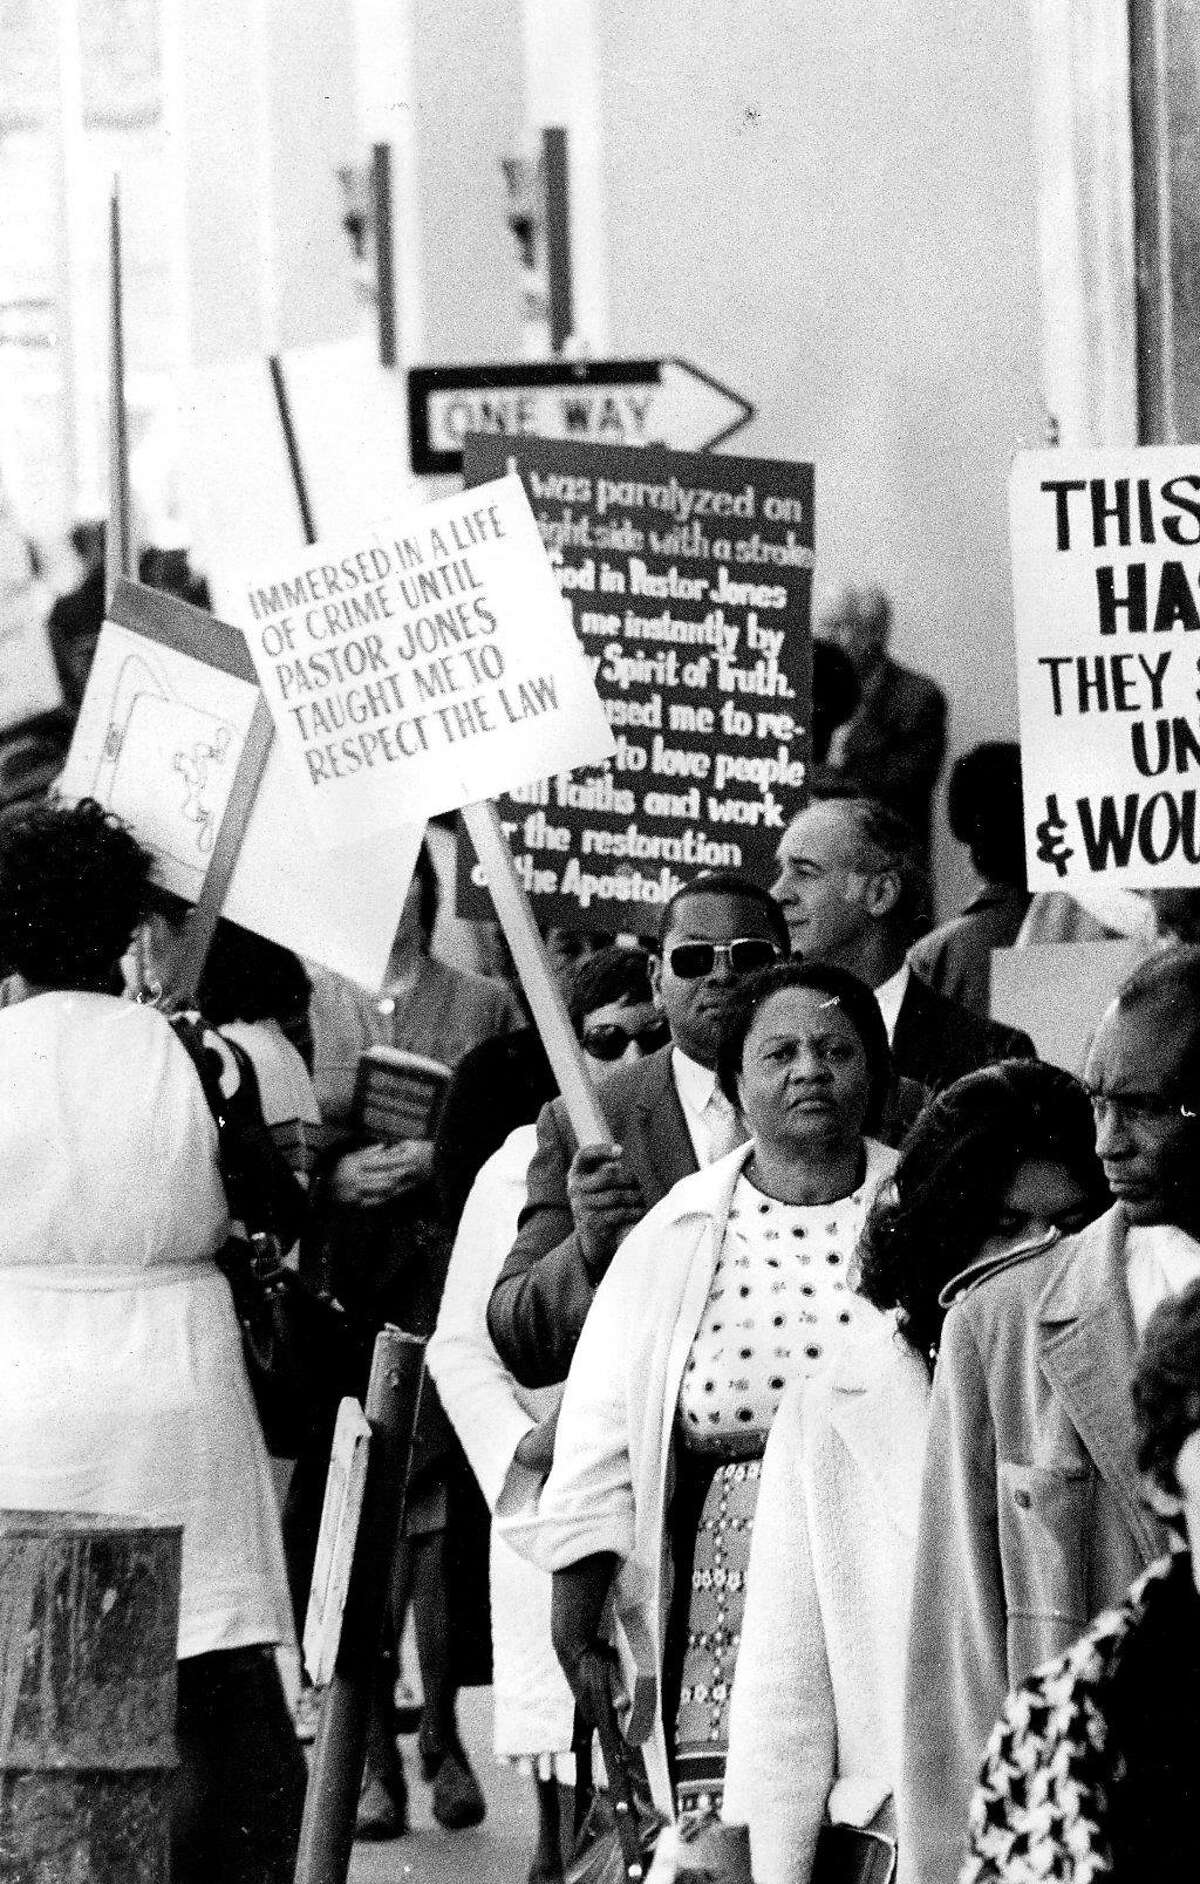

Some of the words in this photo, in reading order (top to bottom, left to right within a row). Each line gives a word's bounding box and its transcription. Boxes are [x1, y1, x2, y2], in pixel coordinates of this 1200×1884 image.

[445, 397, 537, 442] ONE
[562, 395, 653, 433] WAY
[530, 471, 592, 502] was
[598, 476, 755, 522] paralyzed
[763, 497, 802, 521] on
[248, 548, 391, 620] IMMERSED
[395, 537, 424, 569] IN
[430, 528, 450, 559] A
[450, 504, 506, 551] LIFE
[600, 563, 626, 594] in
[628, 557, 709, 601] Pastor
[709, 566, 788, 609] Jones
[261, 617, 296, 657] OF
[306, 585, 395, 640] CRIME
[400, 558, 484, 610] UNTIL
[581, 612, 622, 636] me
[624, 609, 740, 655] instantly
[746, 612, 785, 658] by
[275, 634, 389, 699] PASTOR
[399, 597, 498, 661] JONES
[601, 642, 681, 690] Spirit
[682, 655, 712, 688] of
[711, 652, 796, 698] Truth.
[289, 673, 404, 741] TAUGHT
[413, 656, 461, 702] ME
[461, 644, 505, 685] TO
[1038, 650, 1172, 716] THEY
[304, 716, 430, 786] RESPECT
[434, 696, 496, 744] THE
[499, 674, 560, 723] LAW
[668, 703, 714, 734] me
[720, 700, 754, 737] to
[756, 713, 806, 742] re-
[616, 735, 648, 771] to
[652, 735, 711, 779] love
[714, 745, 806, 793] people
[556, 773, 636, 814] faiths
[643, 788, 701, 819] and
[708, 792, 786, 828] work
[523, 811, 571, 851] the
[581, 824, 743, 868] restoration
[561, 858, 688, 908] Apostoli
